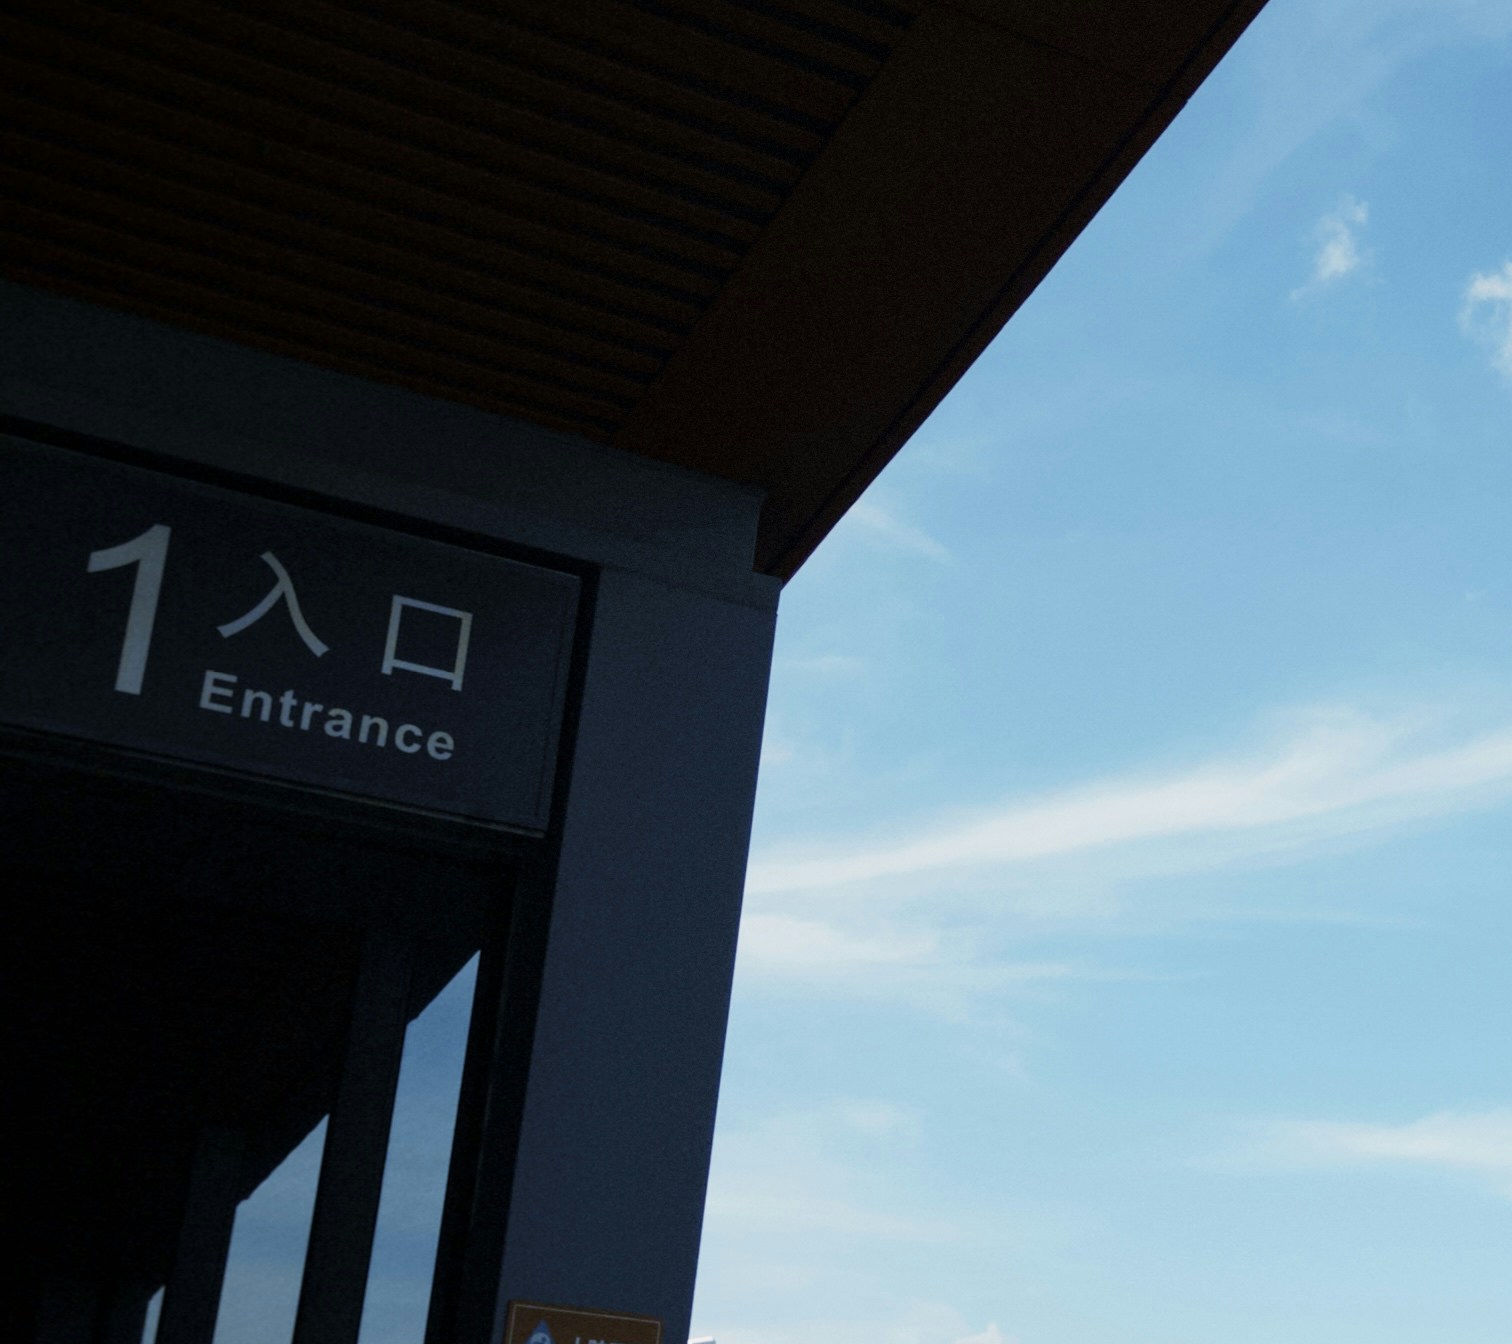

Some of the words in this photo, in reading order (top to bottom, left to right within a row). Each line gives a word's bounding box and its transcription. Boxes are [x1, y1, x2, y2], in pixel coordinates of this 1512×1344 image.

[86, 523, 172, 695] 1
[216, 551, 473, 691] 入口
[199, 670, 456, 761] Entrance
